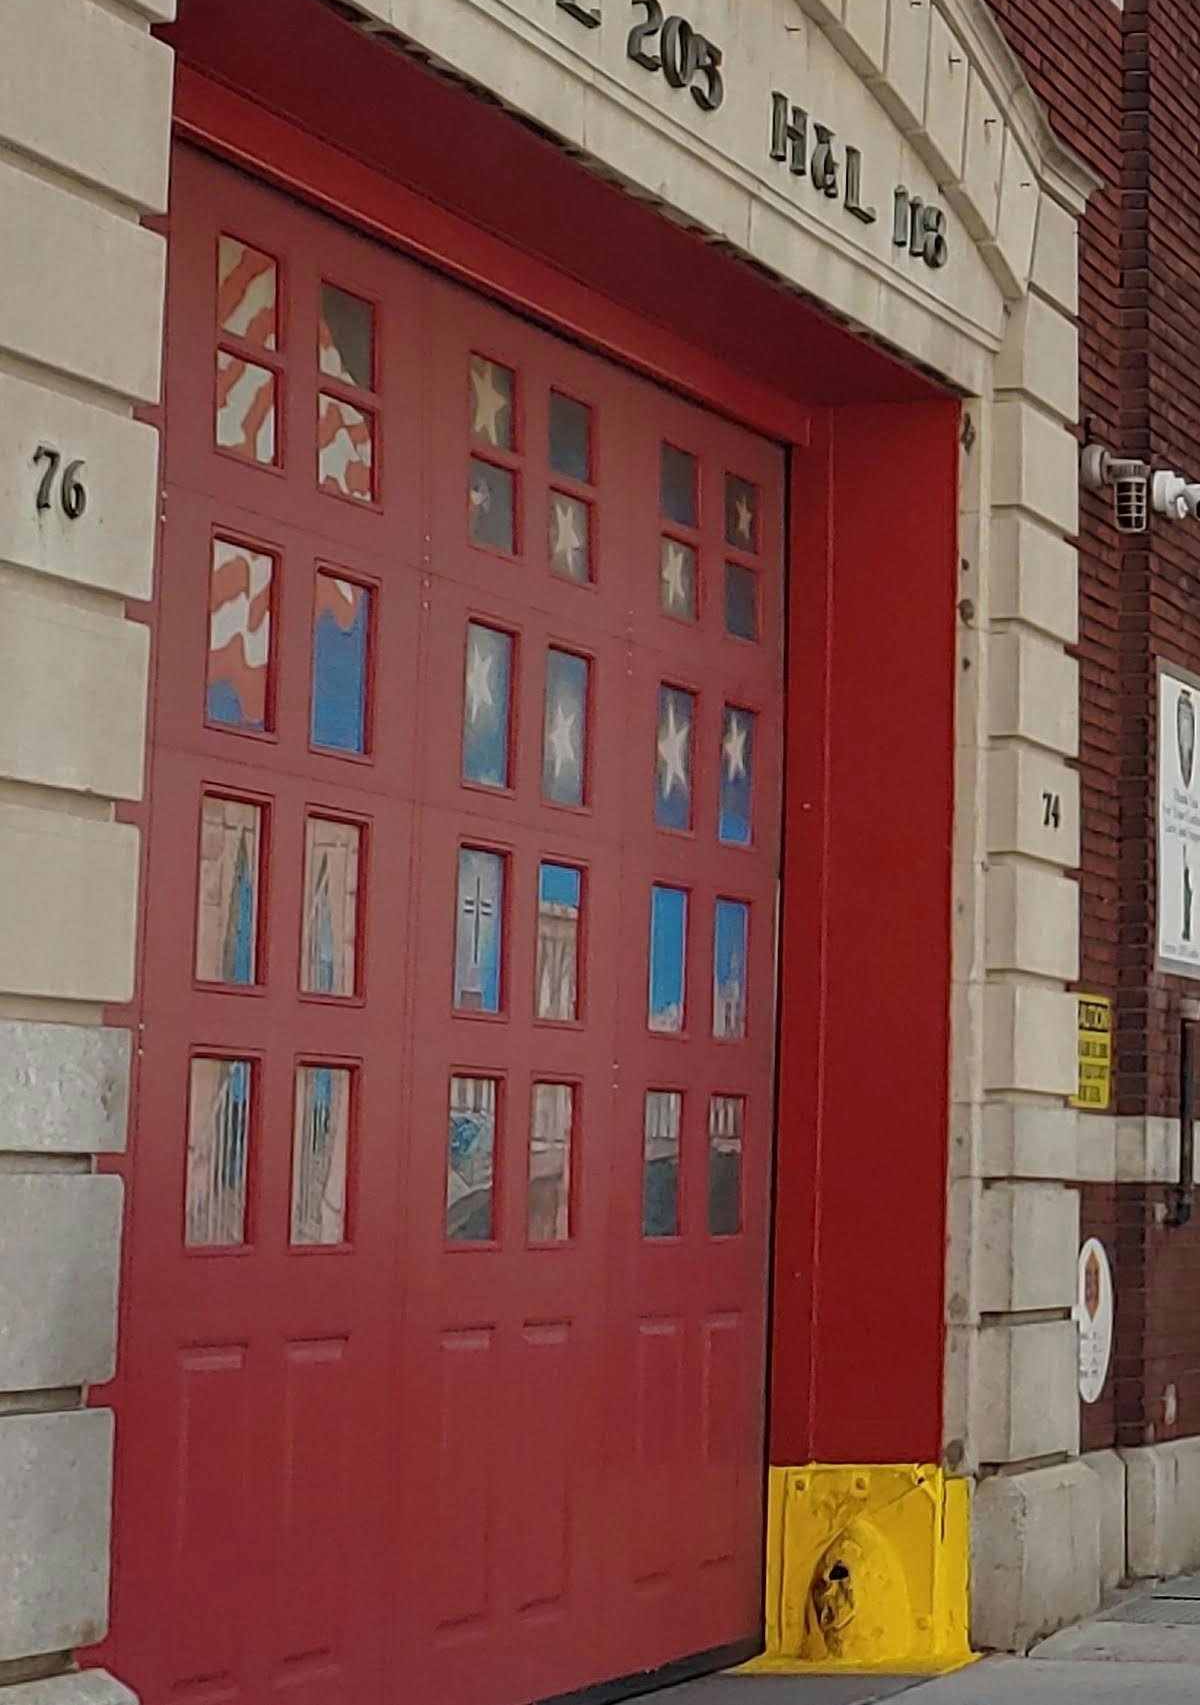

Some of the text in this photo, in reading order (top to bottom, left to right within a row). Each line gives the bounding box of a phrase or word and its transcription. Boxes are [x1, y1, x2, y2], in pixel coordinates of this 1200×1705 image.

[769, 90, 877, 224] H&L
[893, 184, 950, 269] 118
[32, 445, 87, 521] 76
[1042, 792, 1060, 828] 74
